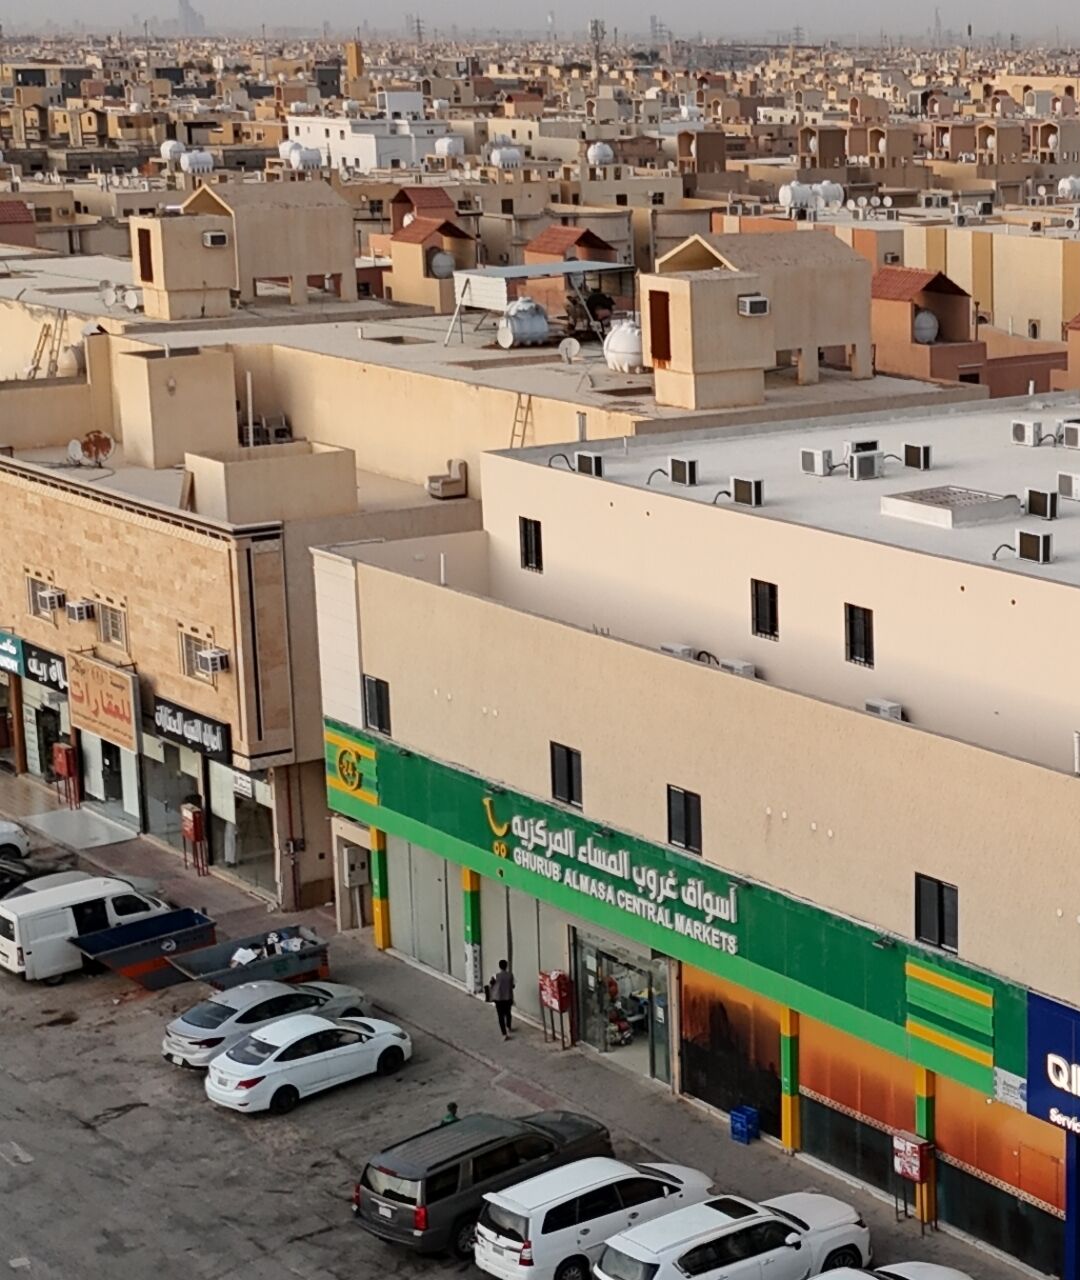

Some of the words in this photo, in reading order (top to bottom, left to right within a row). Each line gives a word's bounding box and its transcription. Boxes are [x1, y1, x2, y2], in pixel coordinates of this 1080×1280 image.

[577, 837, 631, 880] المساء
[512, 847, 562, 882] GHURUB
[563, 868, 616, 906] ALMASA
[616, 889, 674, 930] CENTRAL
[674, 912, 739, 955] MARKETS
[632, 866, 679, 904] غروب
[681, 878, 738, 924] أسواق
